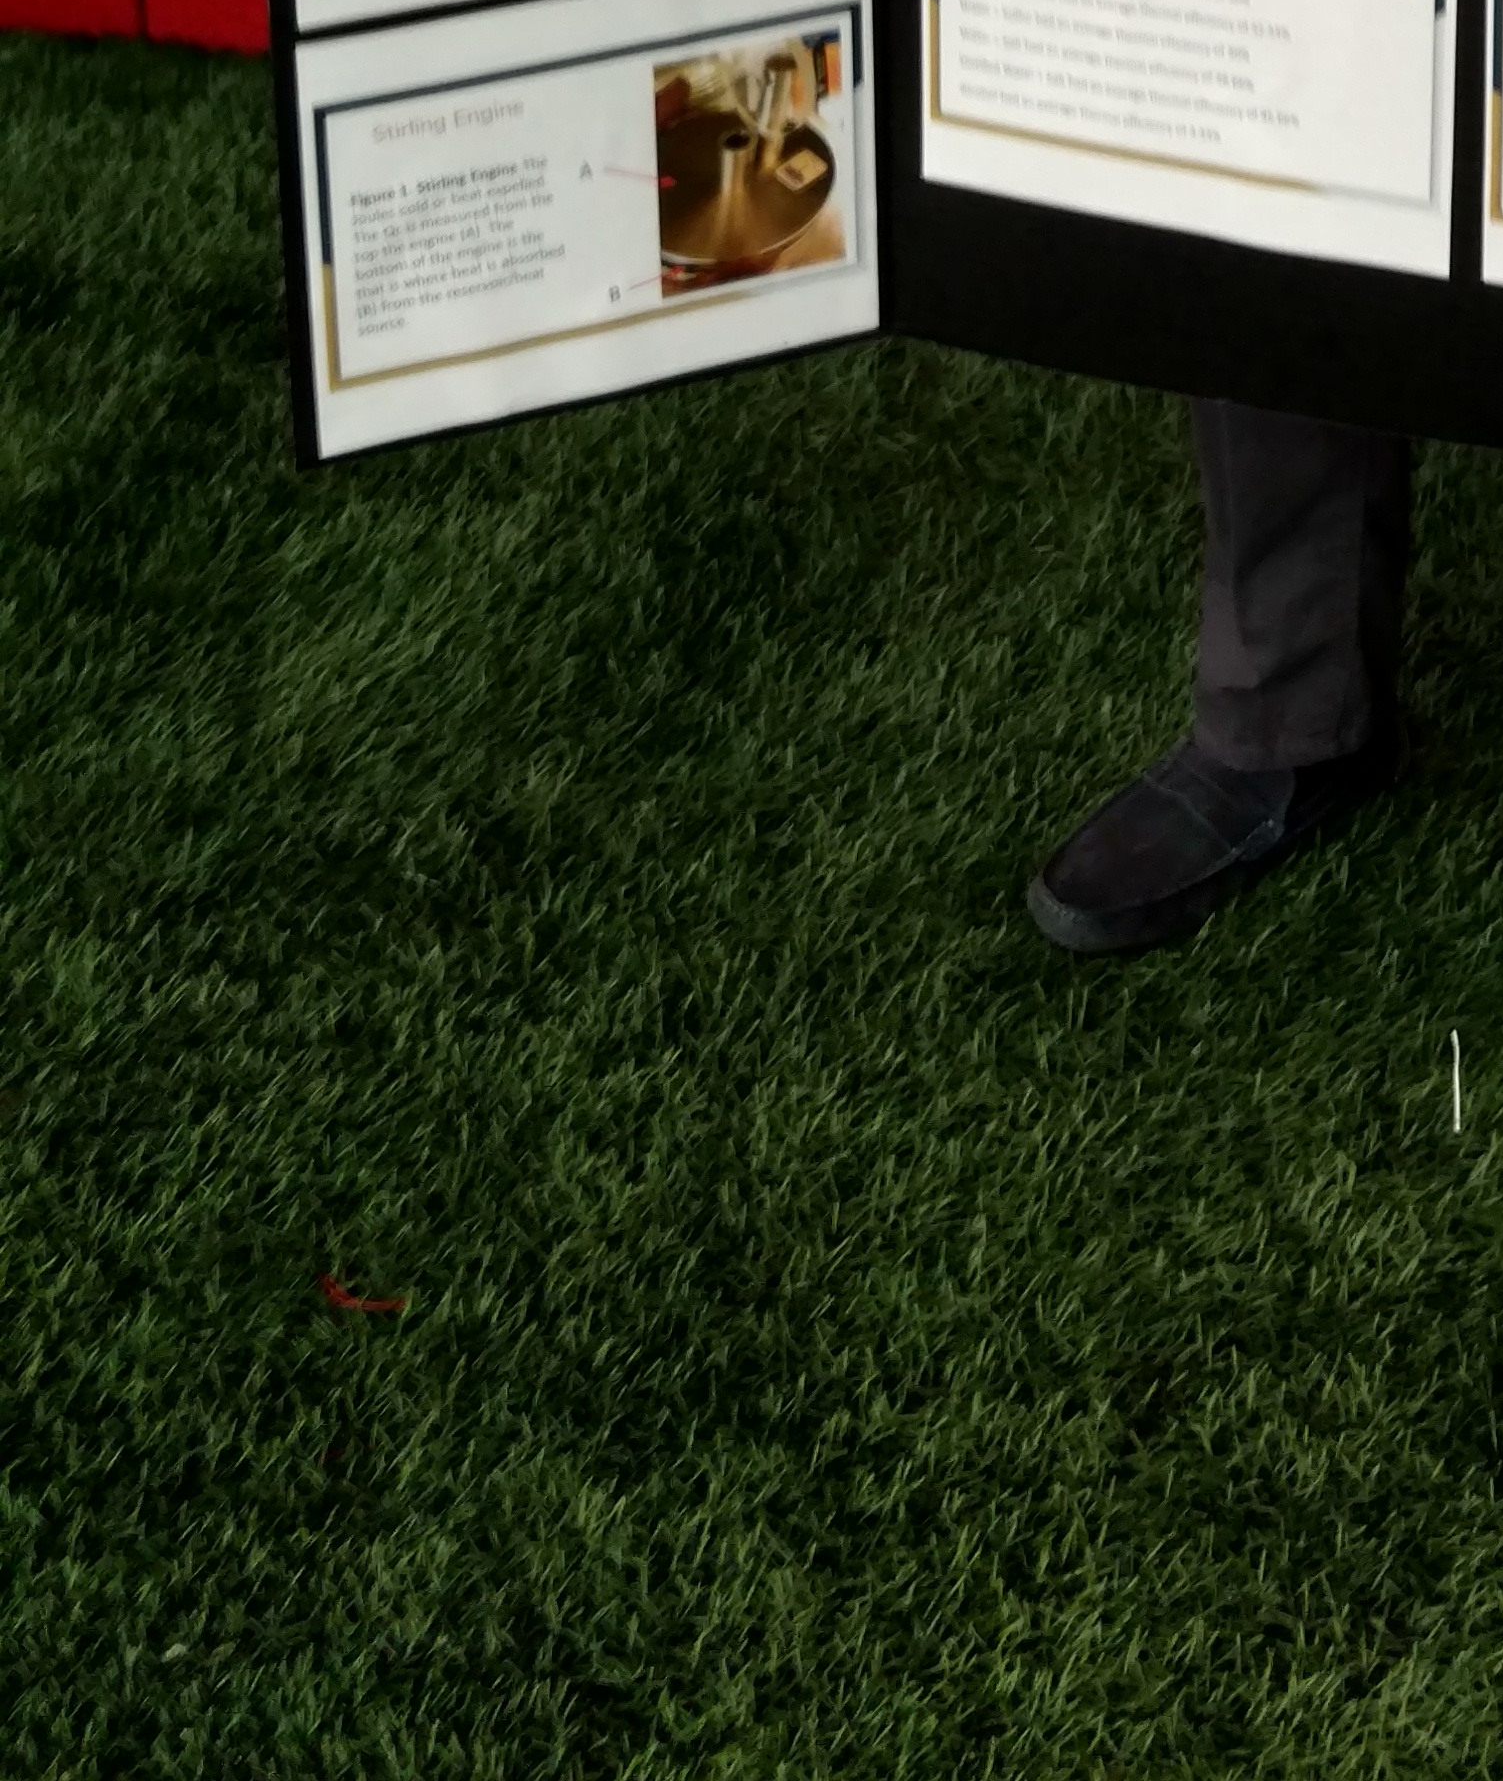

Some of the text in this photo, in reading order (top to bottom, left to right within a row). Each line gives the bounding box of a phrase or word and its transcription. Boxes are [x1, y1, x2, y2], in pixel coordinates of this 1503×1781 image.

[371, 100, 524, 144] Stirling Engine
[579, 160, 593, 180] A
[608, 285, 621, 302] B
